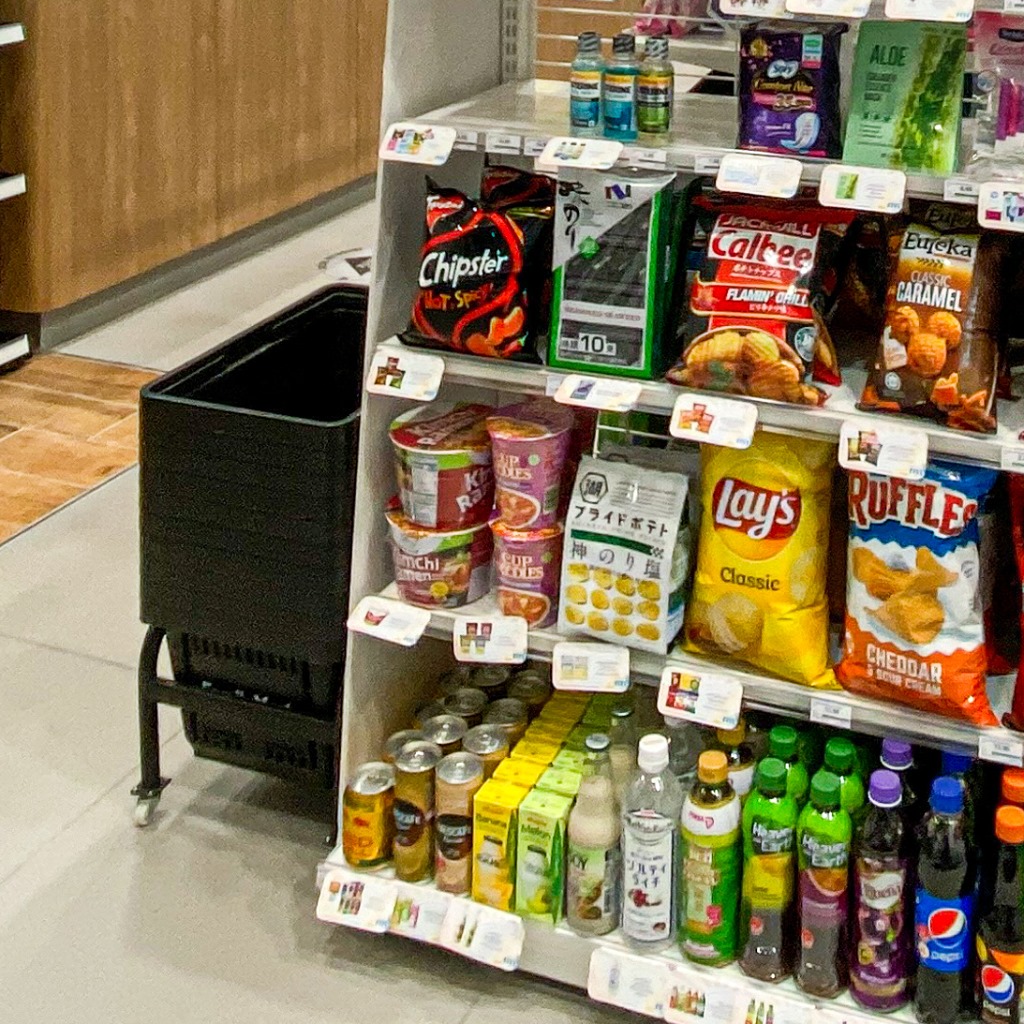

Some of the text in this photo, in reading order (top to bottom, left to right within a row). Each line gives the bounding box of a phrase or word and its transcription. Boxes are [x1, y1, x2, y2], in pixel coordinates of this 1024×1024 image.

[869, 44, 909, 66] ALOE
[712, 229, 813, 268] Calbee
[418, 248, 509, 288] Chipster
[911, 269, 952, 288] CLASSIC
[726, 288, 774, 303] FLAMIN'
[896, 280, 962, 313] CARAMEL
[580, 335, 605, 353] 10
[715, 479, 797, 540] Lay's
[849, 469, 978, 536] RUFFLES
[720, 566, 781, 591] Classic
[866, 643, 943, 684] CHEDDAR
